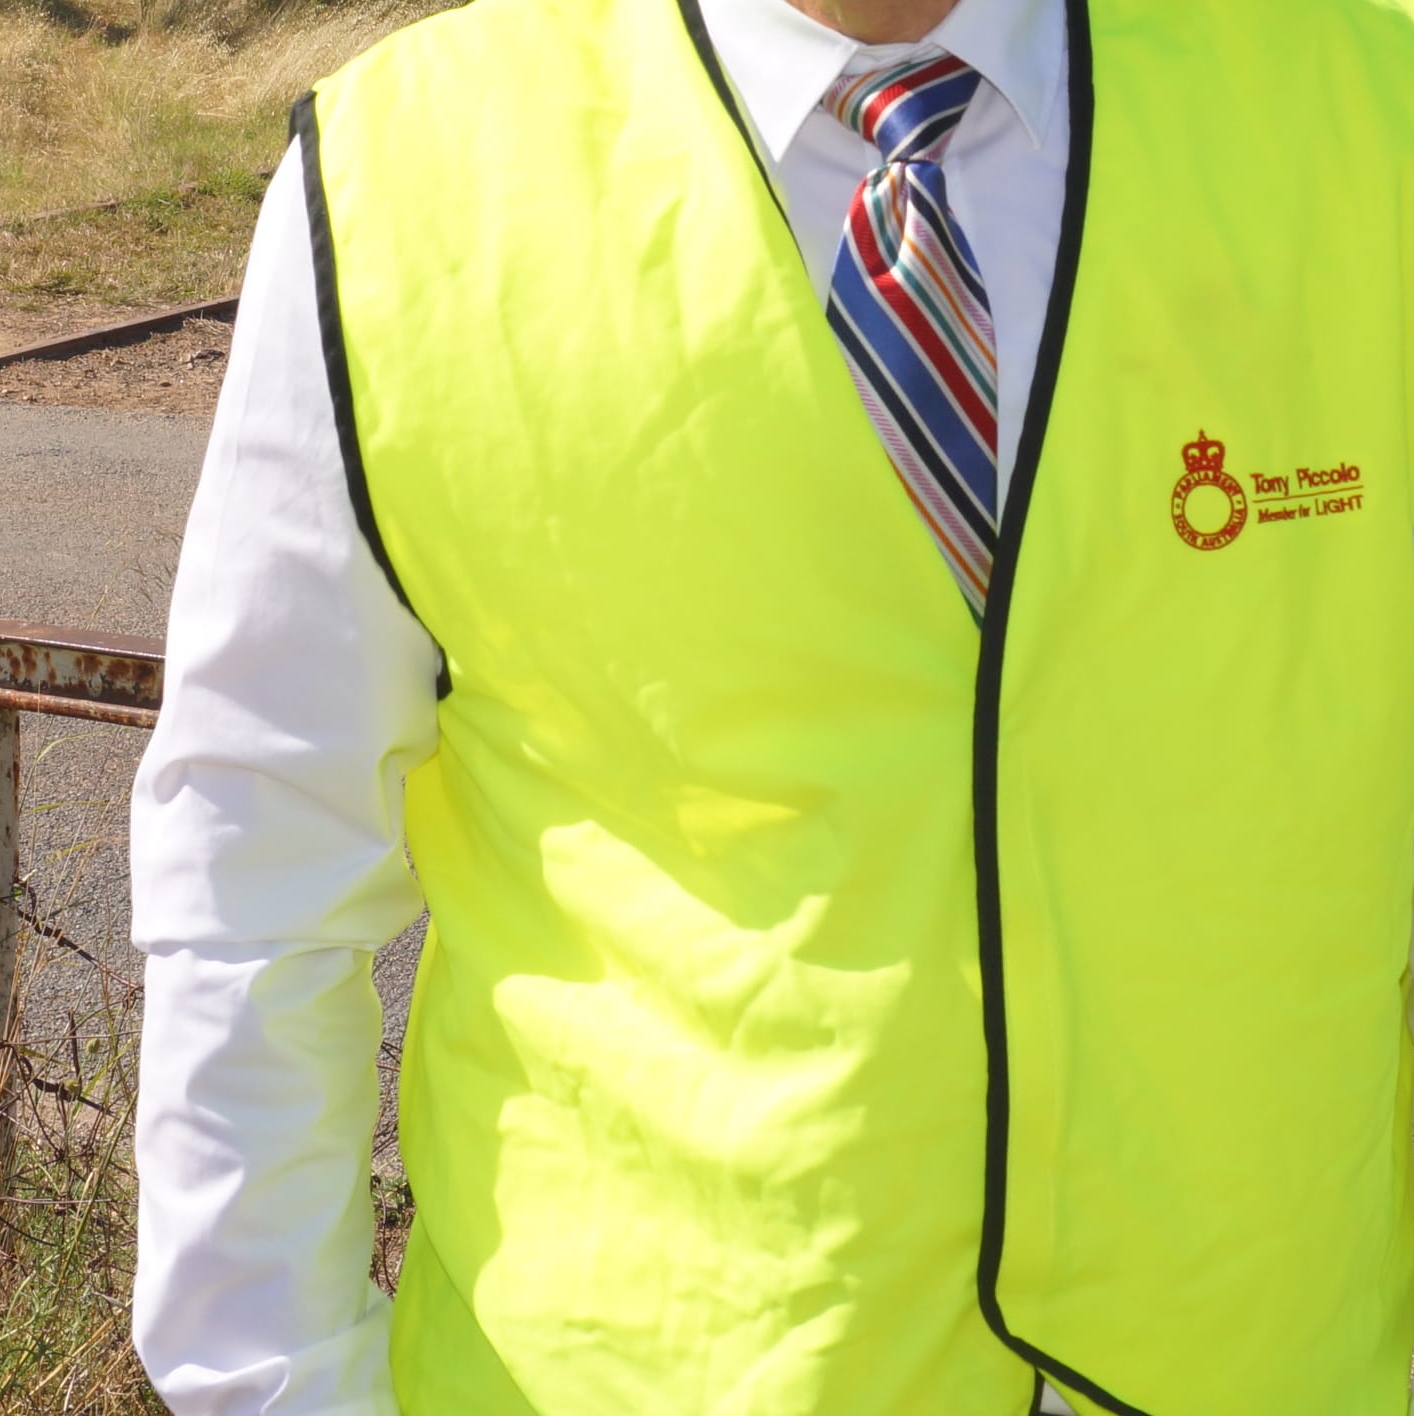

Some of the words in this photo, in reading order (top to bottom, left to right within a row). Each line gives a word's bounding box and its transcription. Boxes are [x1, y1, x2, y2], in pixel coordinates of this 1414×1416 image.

[1250, 473, 1289, 496] Tony
[1296, 462, 1360, 489] Piccolo
[1258, 507, 1297, 524] Member
[1315, 495, 1363, 516] LIGHT
